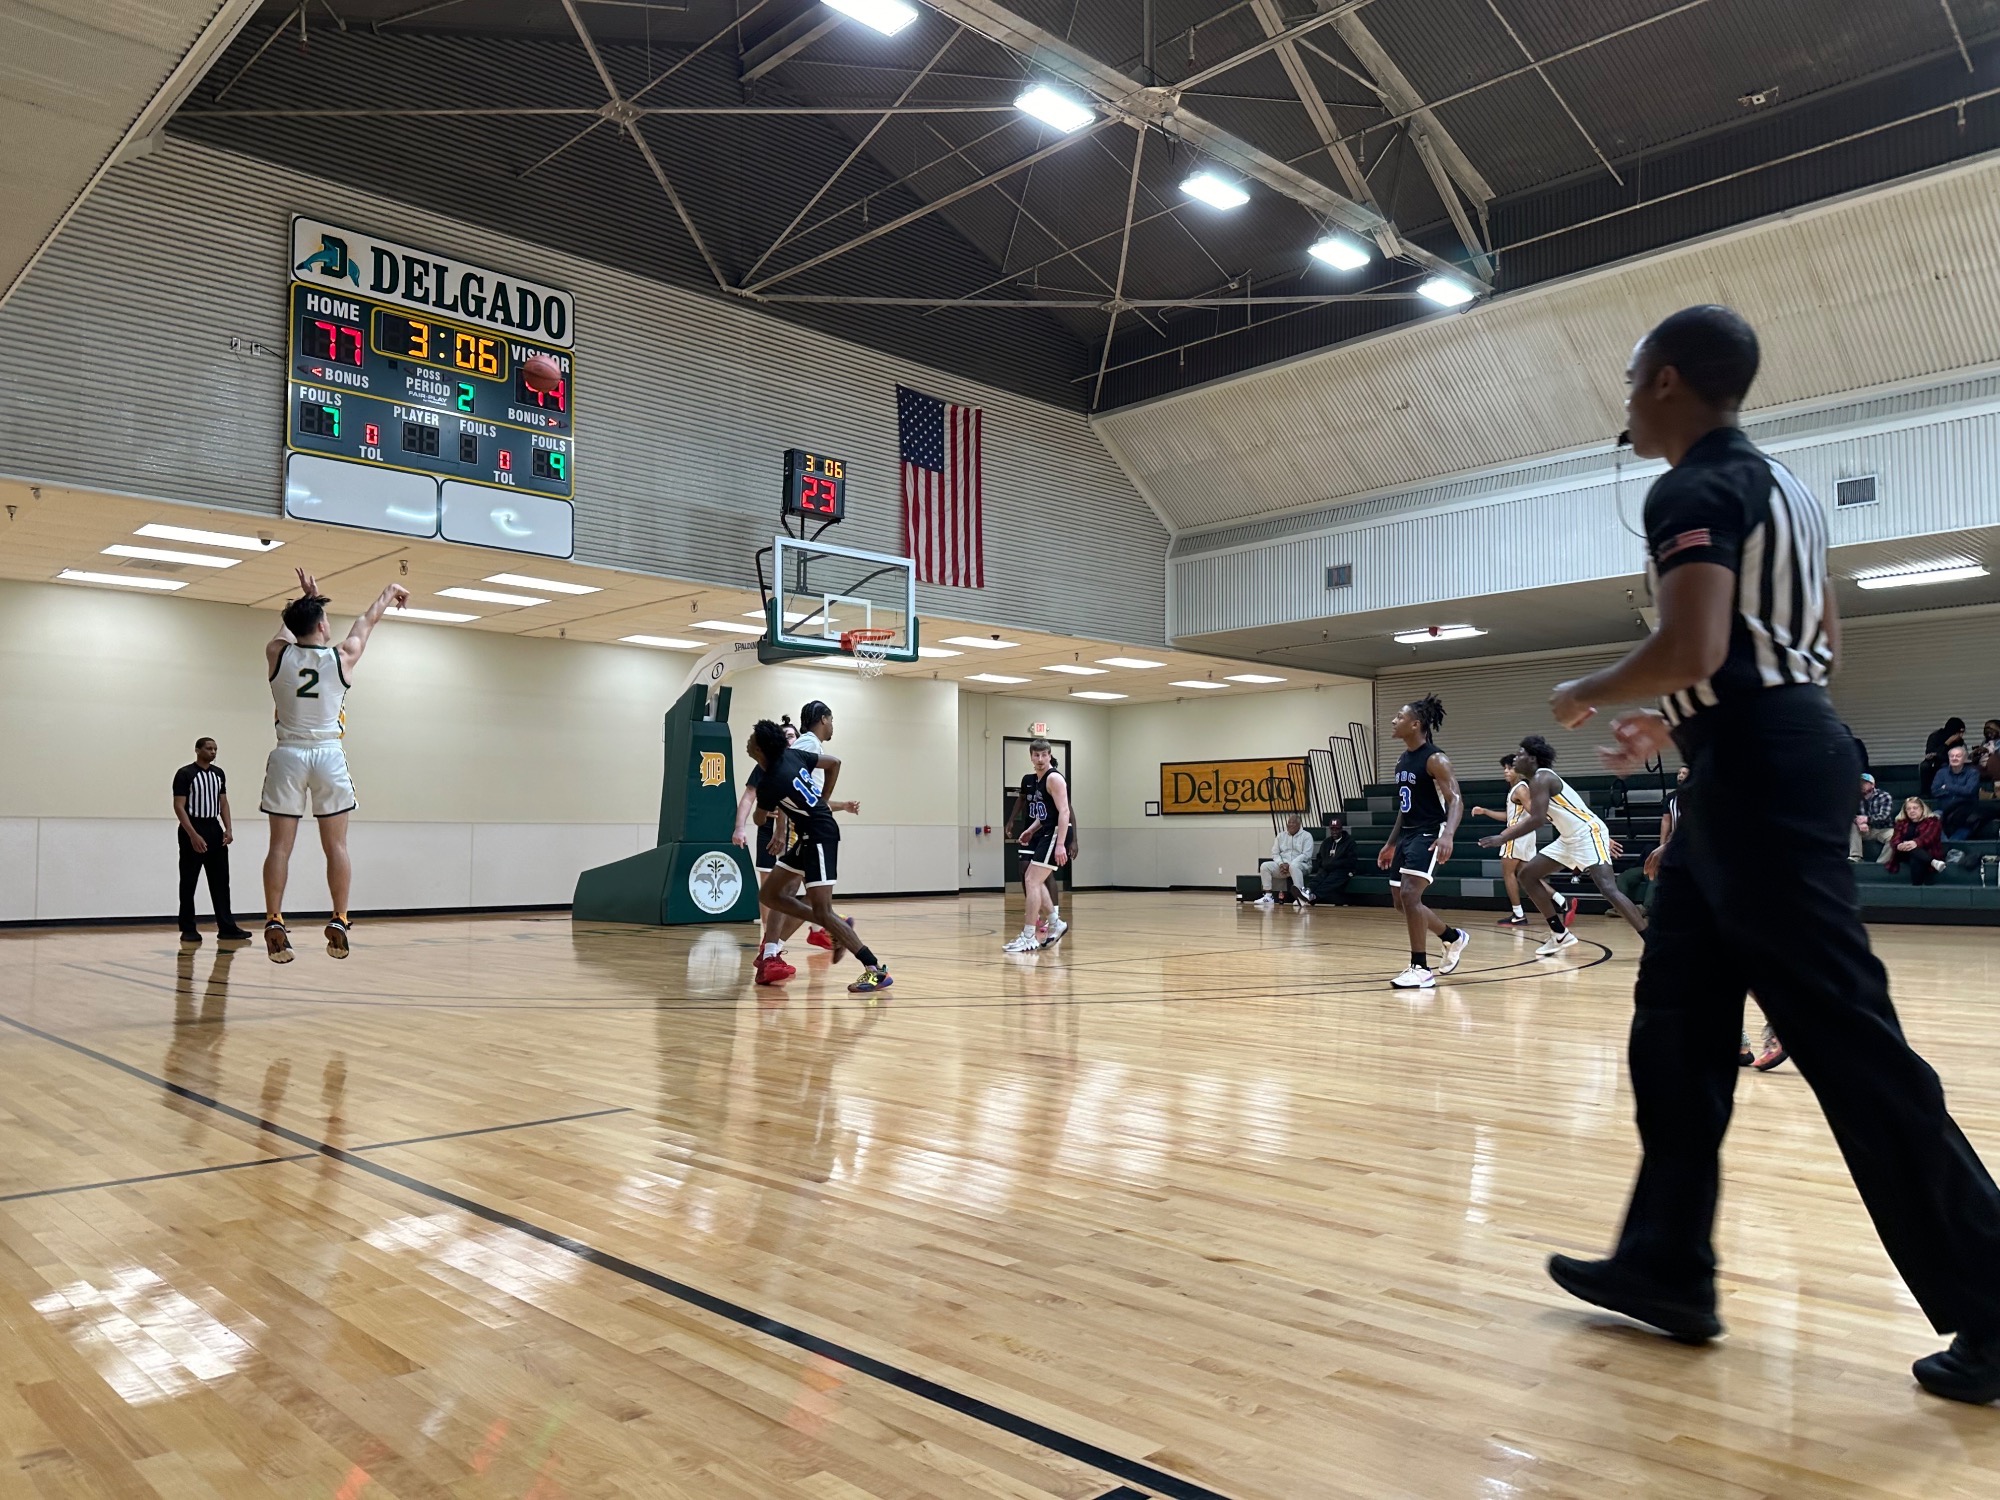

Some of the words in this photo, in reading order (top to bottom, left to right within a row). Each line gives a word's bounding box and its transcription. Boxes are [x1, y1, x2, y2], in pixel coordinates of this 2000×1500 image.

[370, 246, 566, 339] DELGADO
[307, 294, 359, 322] HOME
[315, 321, 361, 366] 77
[408, 321, 498, 375] 3:06
[511, 344, 570, 373] VISOR
[325, 368, 369, 388] BONUS
[406, 377, 451, 397] PERIOD
[416, 367, 440, 381] POSS
[300, 386, 342, 406] FOULS
[459, 383, 474, 411] 2
[322, 406, 340, 437] 7
[393, 406, 439, 426] PLAYER
[460, 420, 497, 437] FOULS
[508, 408, 545, 427] BONUS
[366, 424, 378, 445] 0
[531, 435, 566, 452] FOULS
[359, 446, 384, 462] TOL
[499, 451, 511, 470] 0
[550, 452, 565, 480] 9
[494, 471, 515, 486] TOL
[802, 476, 835, 513] 23
[735, 641, 759, 652] SPALDIN
[296, 668, 320, 699] 2
[1171, 766, 1296, 812] Delgado
[1399, 785, 1412, 813] 3
